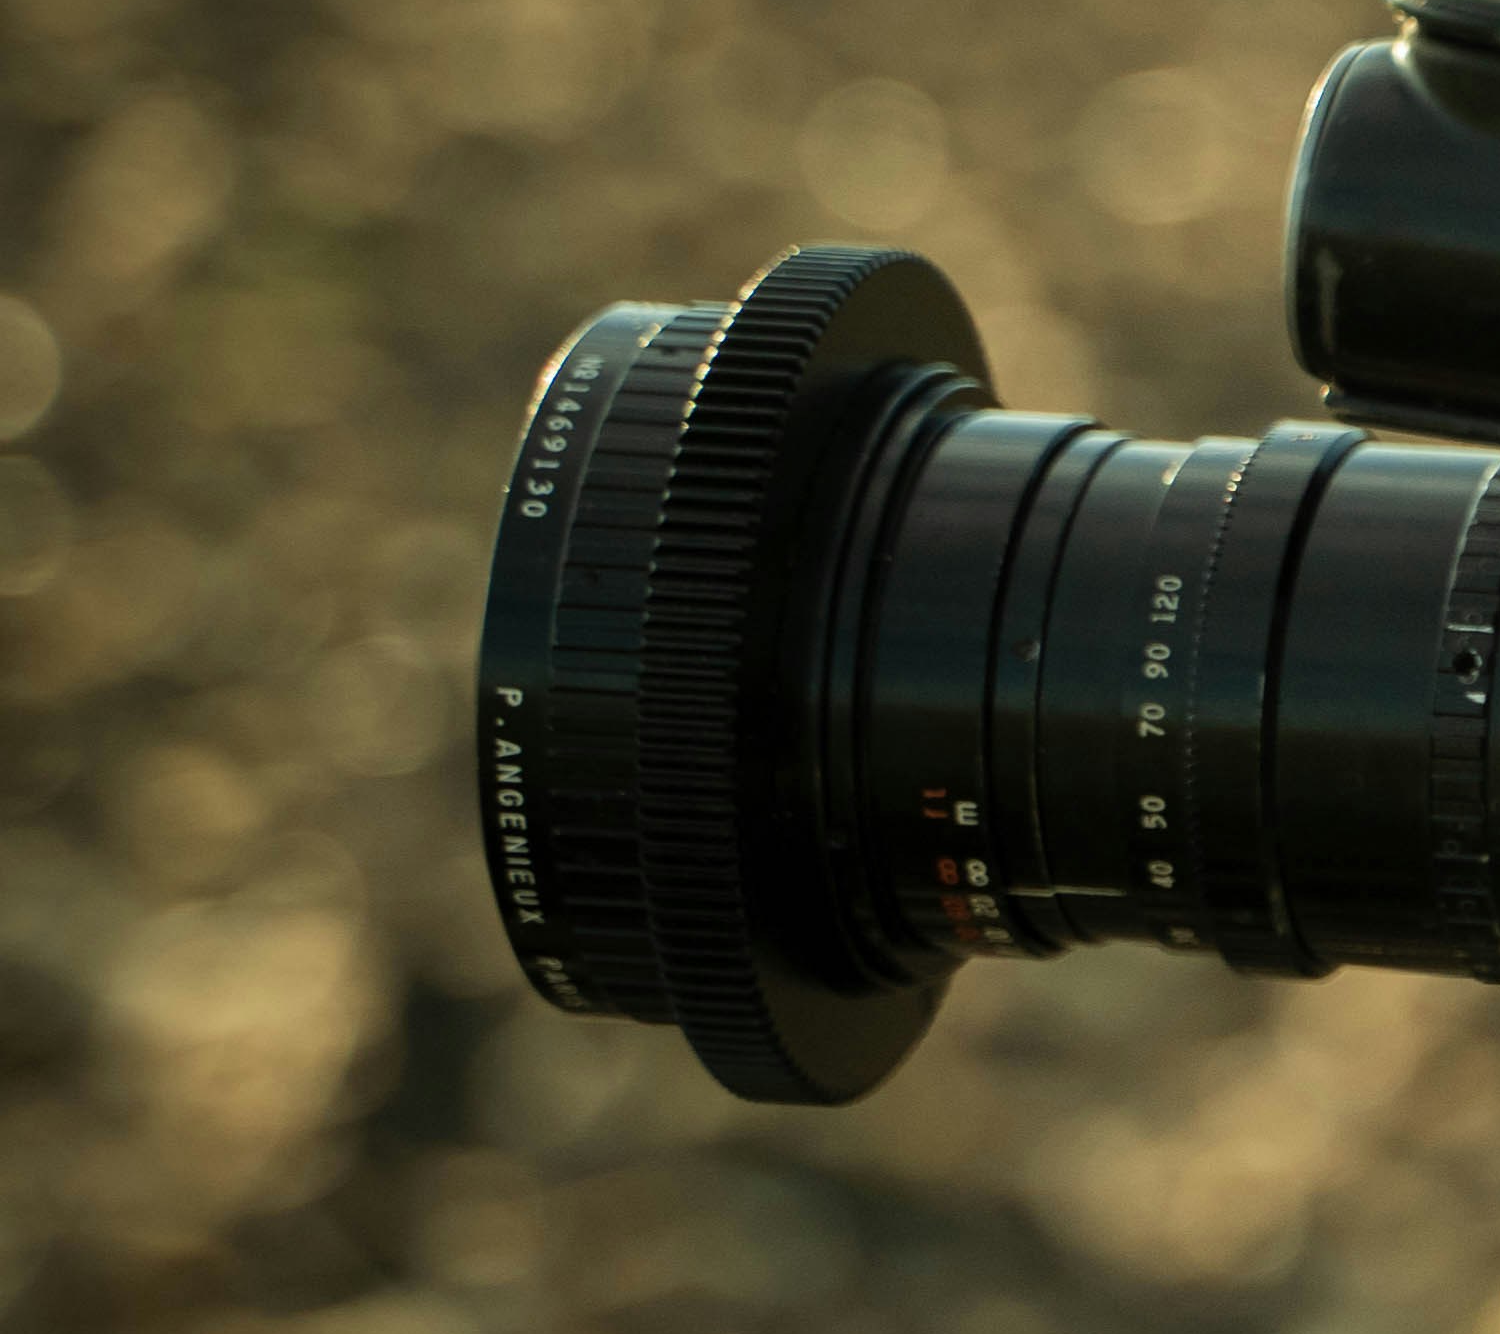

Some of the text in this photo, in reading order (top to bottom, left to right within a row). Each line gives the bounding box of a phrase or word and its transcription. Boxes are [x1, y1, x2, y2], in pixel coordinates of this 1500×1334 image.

[1151, 574, 1183, 625] 120
[1144, 642, 1172, 679] 90
[1138, 702, 1166, 738] 70
[1142, 794, 1168, 831] 50
